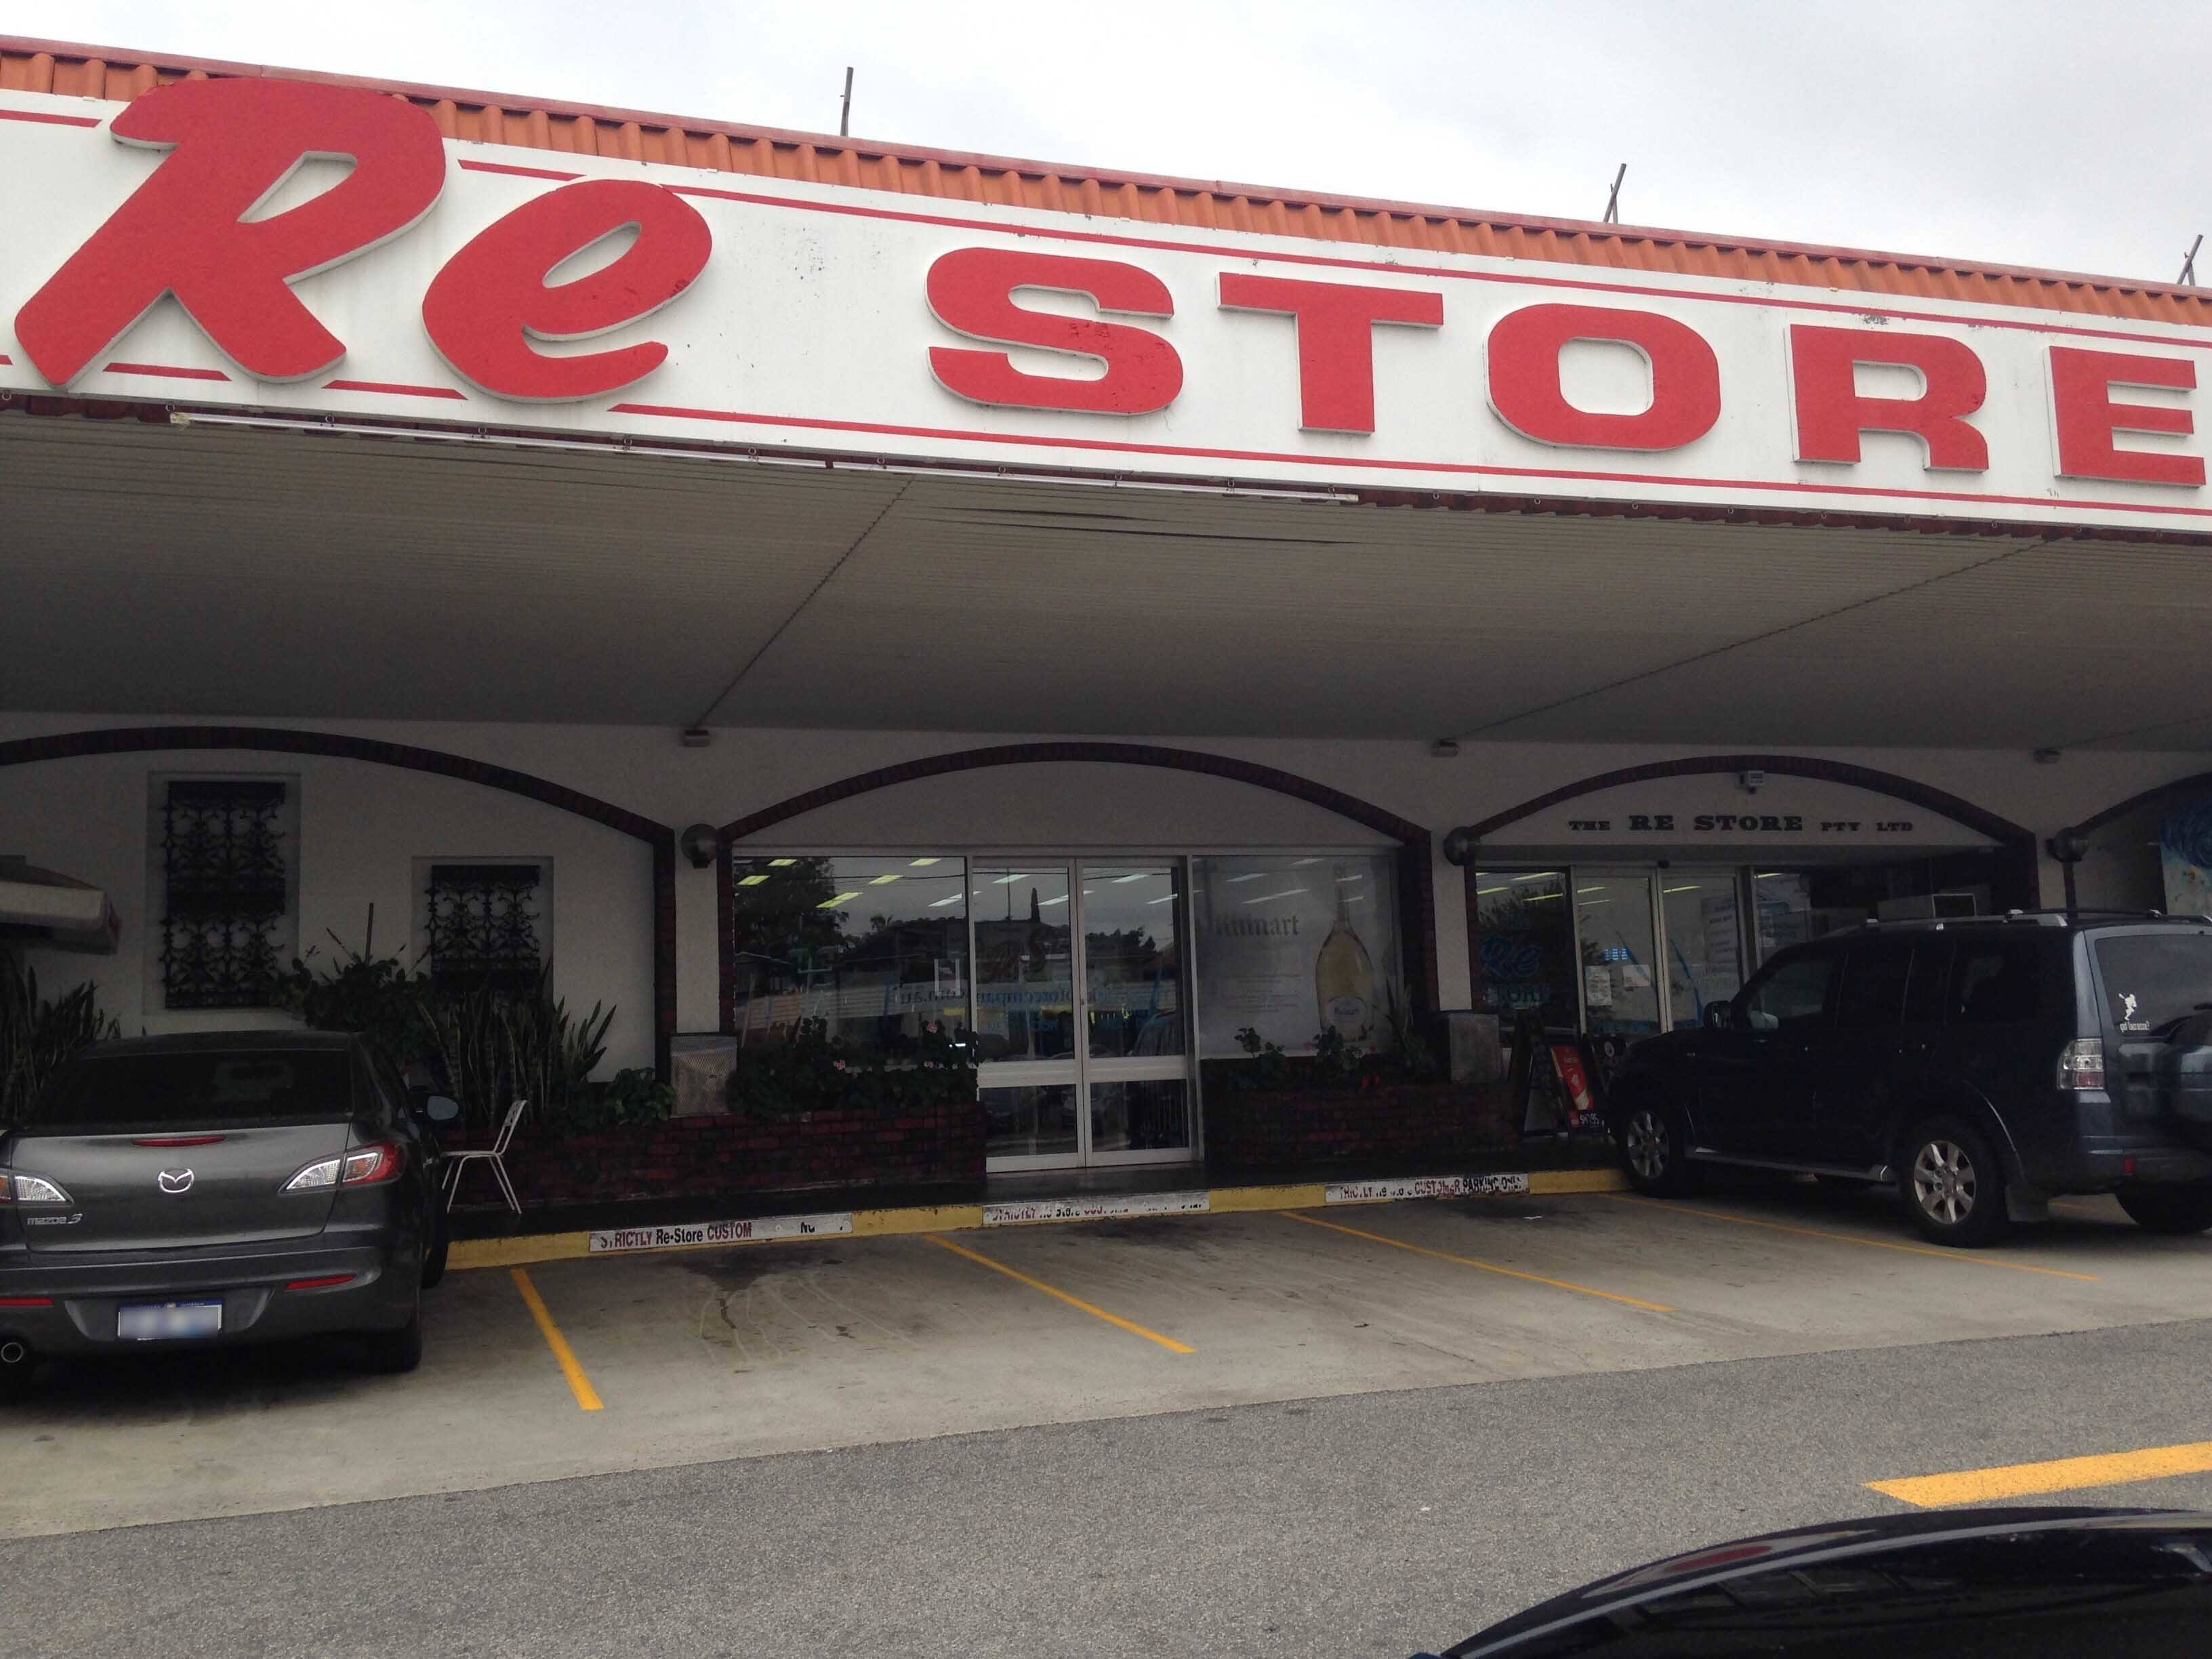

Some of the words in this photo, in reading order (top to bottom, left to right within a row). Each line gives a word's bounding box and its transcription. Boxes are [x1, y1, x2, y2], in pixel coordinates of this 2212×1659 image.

[14, 77, 712, 404] Re
[926, 246, 2207, 487] STORE
[1569, 821, 1611, 831] THE
[1629, 815, 1674, 831] RE
[1694, 815, 1803, 832] STORE
[1820, 821, 1861, 832] PTY
[1877, 822, 1914, 832] LTD
[655, 1227, 703, 1244] Re-Store
